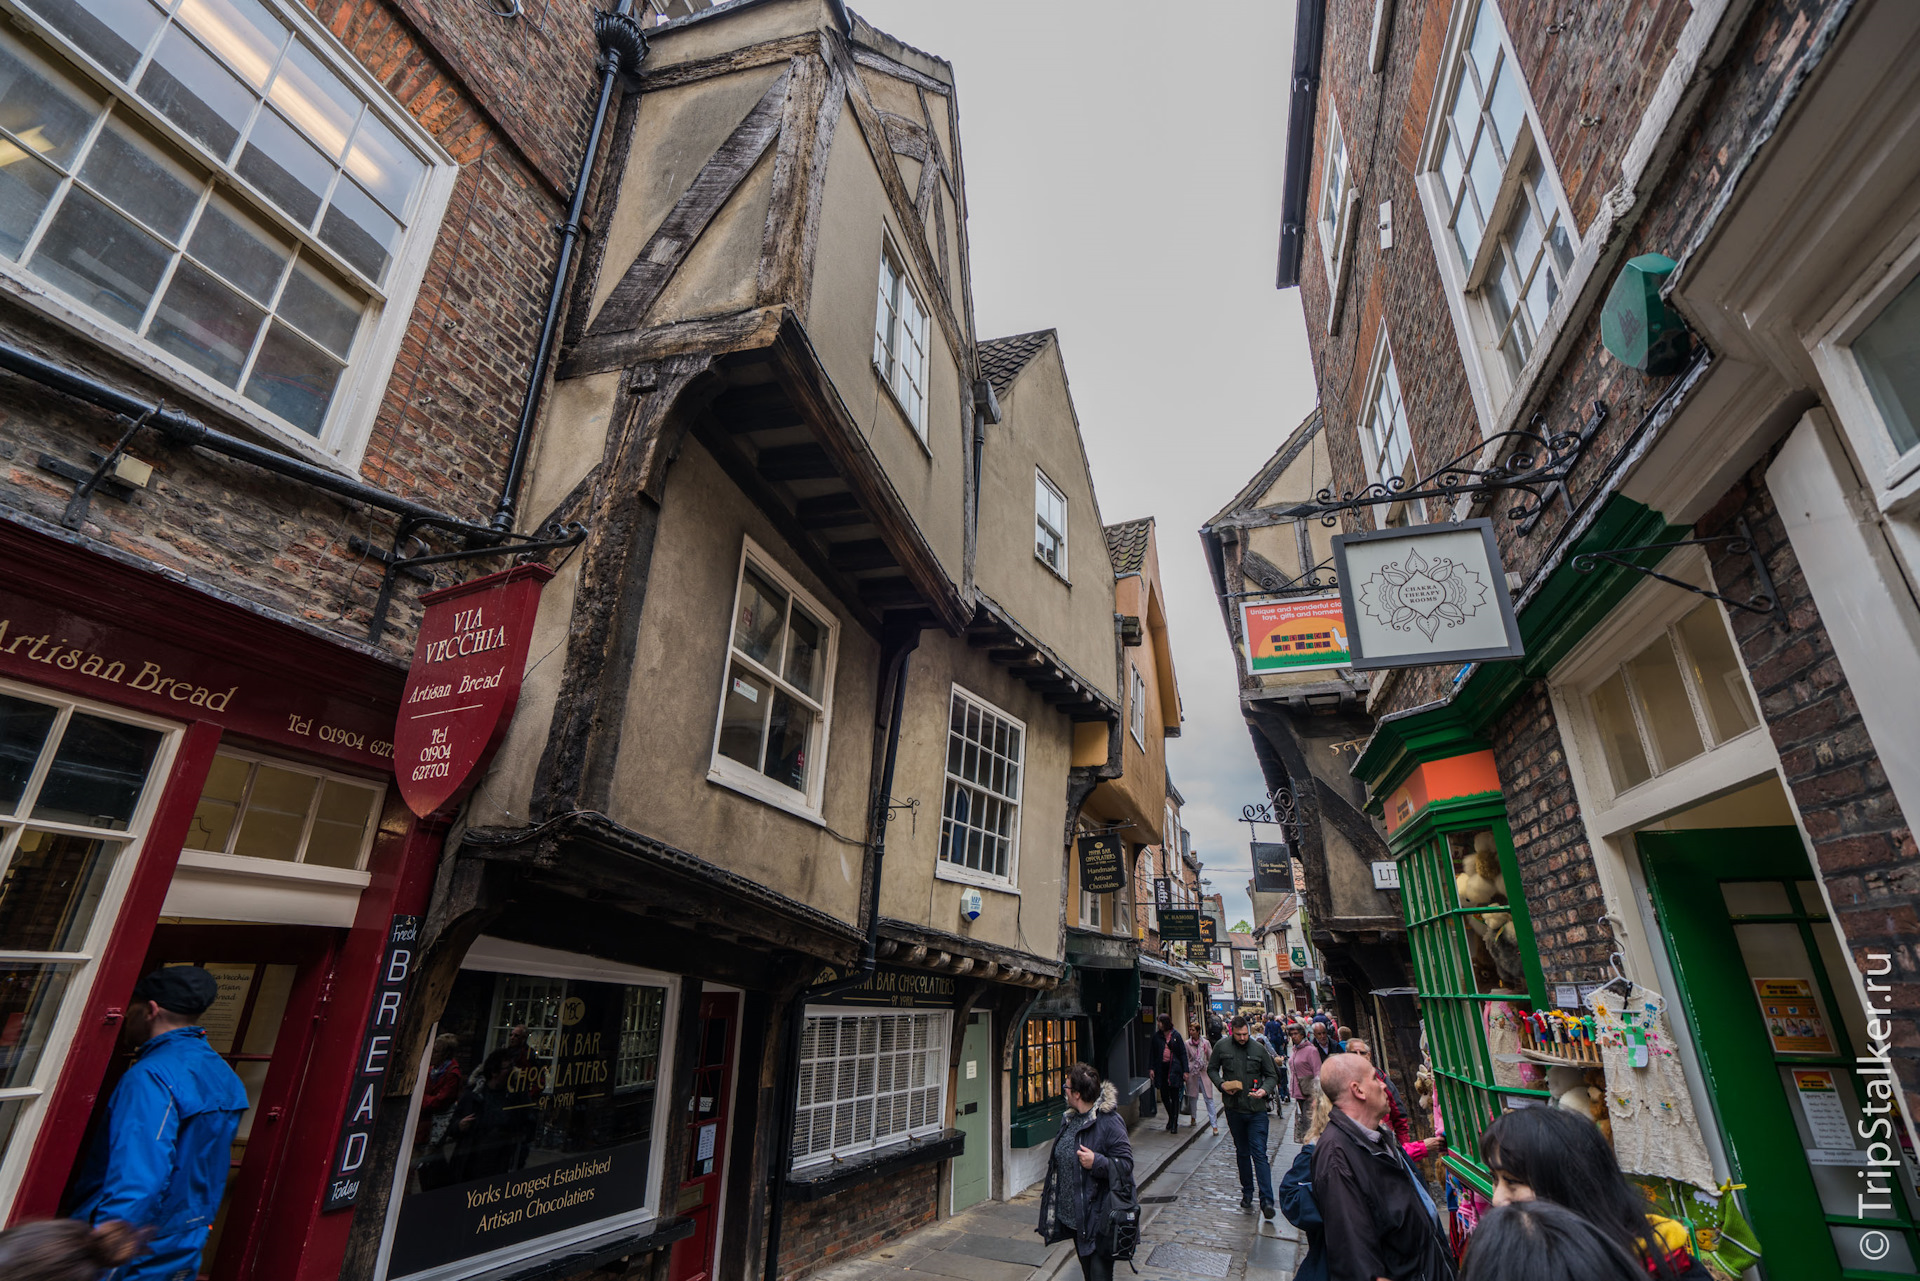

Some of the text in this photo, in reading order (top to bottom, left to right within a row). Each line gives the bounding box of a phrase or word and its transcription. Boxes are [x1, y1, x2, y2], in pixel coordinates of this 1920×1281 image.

[1404, 590, 1440, 598] THERAPY
[453, 606, 483, 634] VIA
[1250, 607, 1275, 615] Unique
[1293, 603, 1329, 611] wonderful
[1280, 612, 1295, 620] gifts
[425, 625, 507, 664] VECCHIA
[127, 660, 239, 713] Bread
[407, 665, 506, 704] Artisan Bread
[287, 712, 395, 760] Tel 01904 627
[430, 726, 449, 745] Tel
[420, 743, 452, 763] 01904
[412, 761, 450, 782] 627701
[1087, 865, 1118, 874] Handmade
[392, 922, 417, 943] Fresh
[223, 973, 250, 981] Vecchia
[876, 971, 896, 992] BAR
[899, 973, 955, 996] CHOCOLATIERS
[574, 1032, 602, 1056] BAR
[340, 948, 412, 1172] BREAD
[553, 1092, 576, 1108] YORK
[331, 1179, 360, 1201] Today
[466, 1155, 612, 1209] Yorks Longest Established
[476, 1187, 596, 1234] Artisan Chocolatiers
